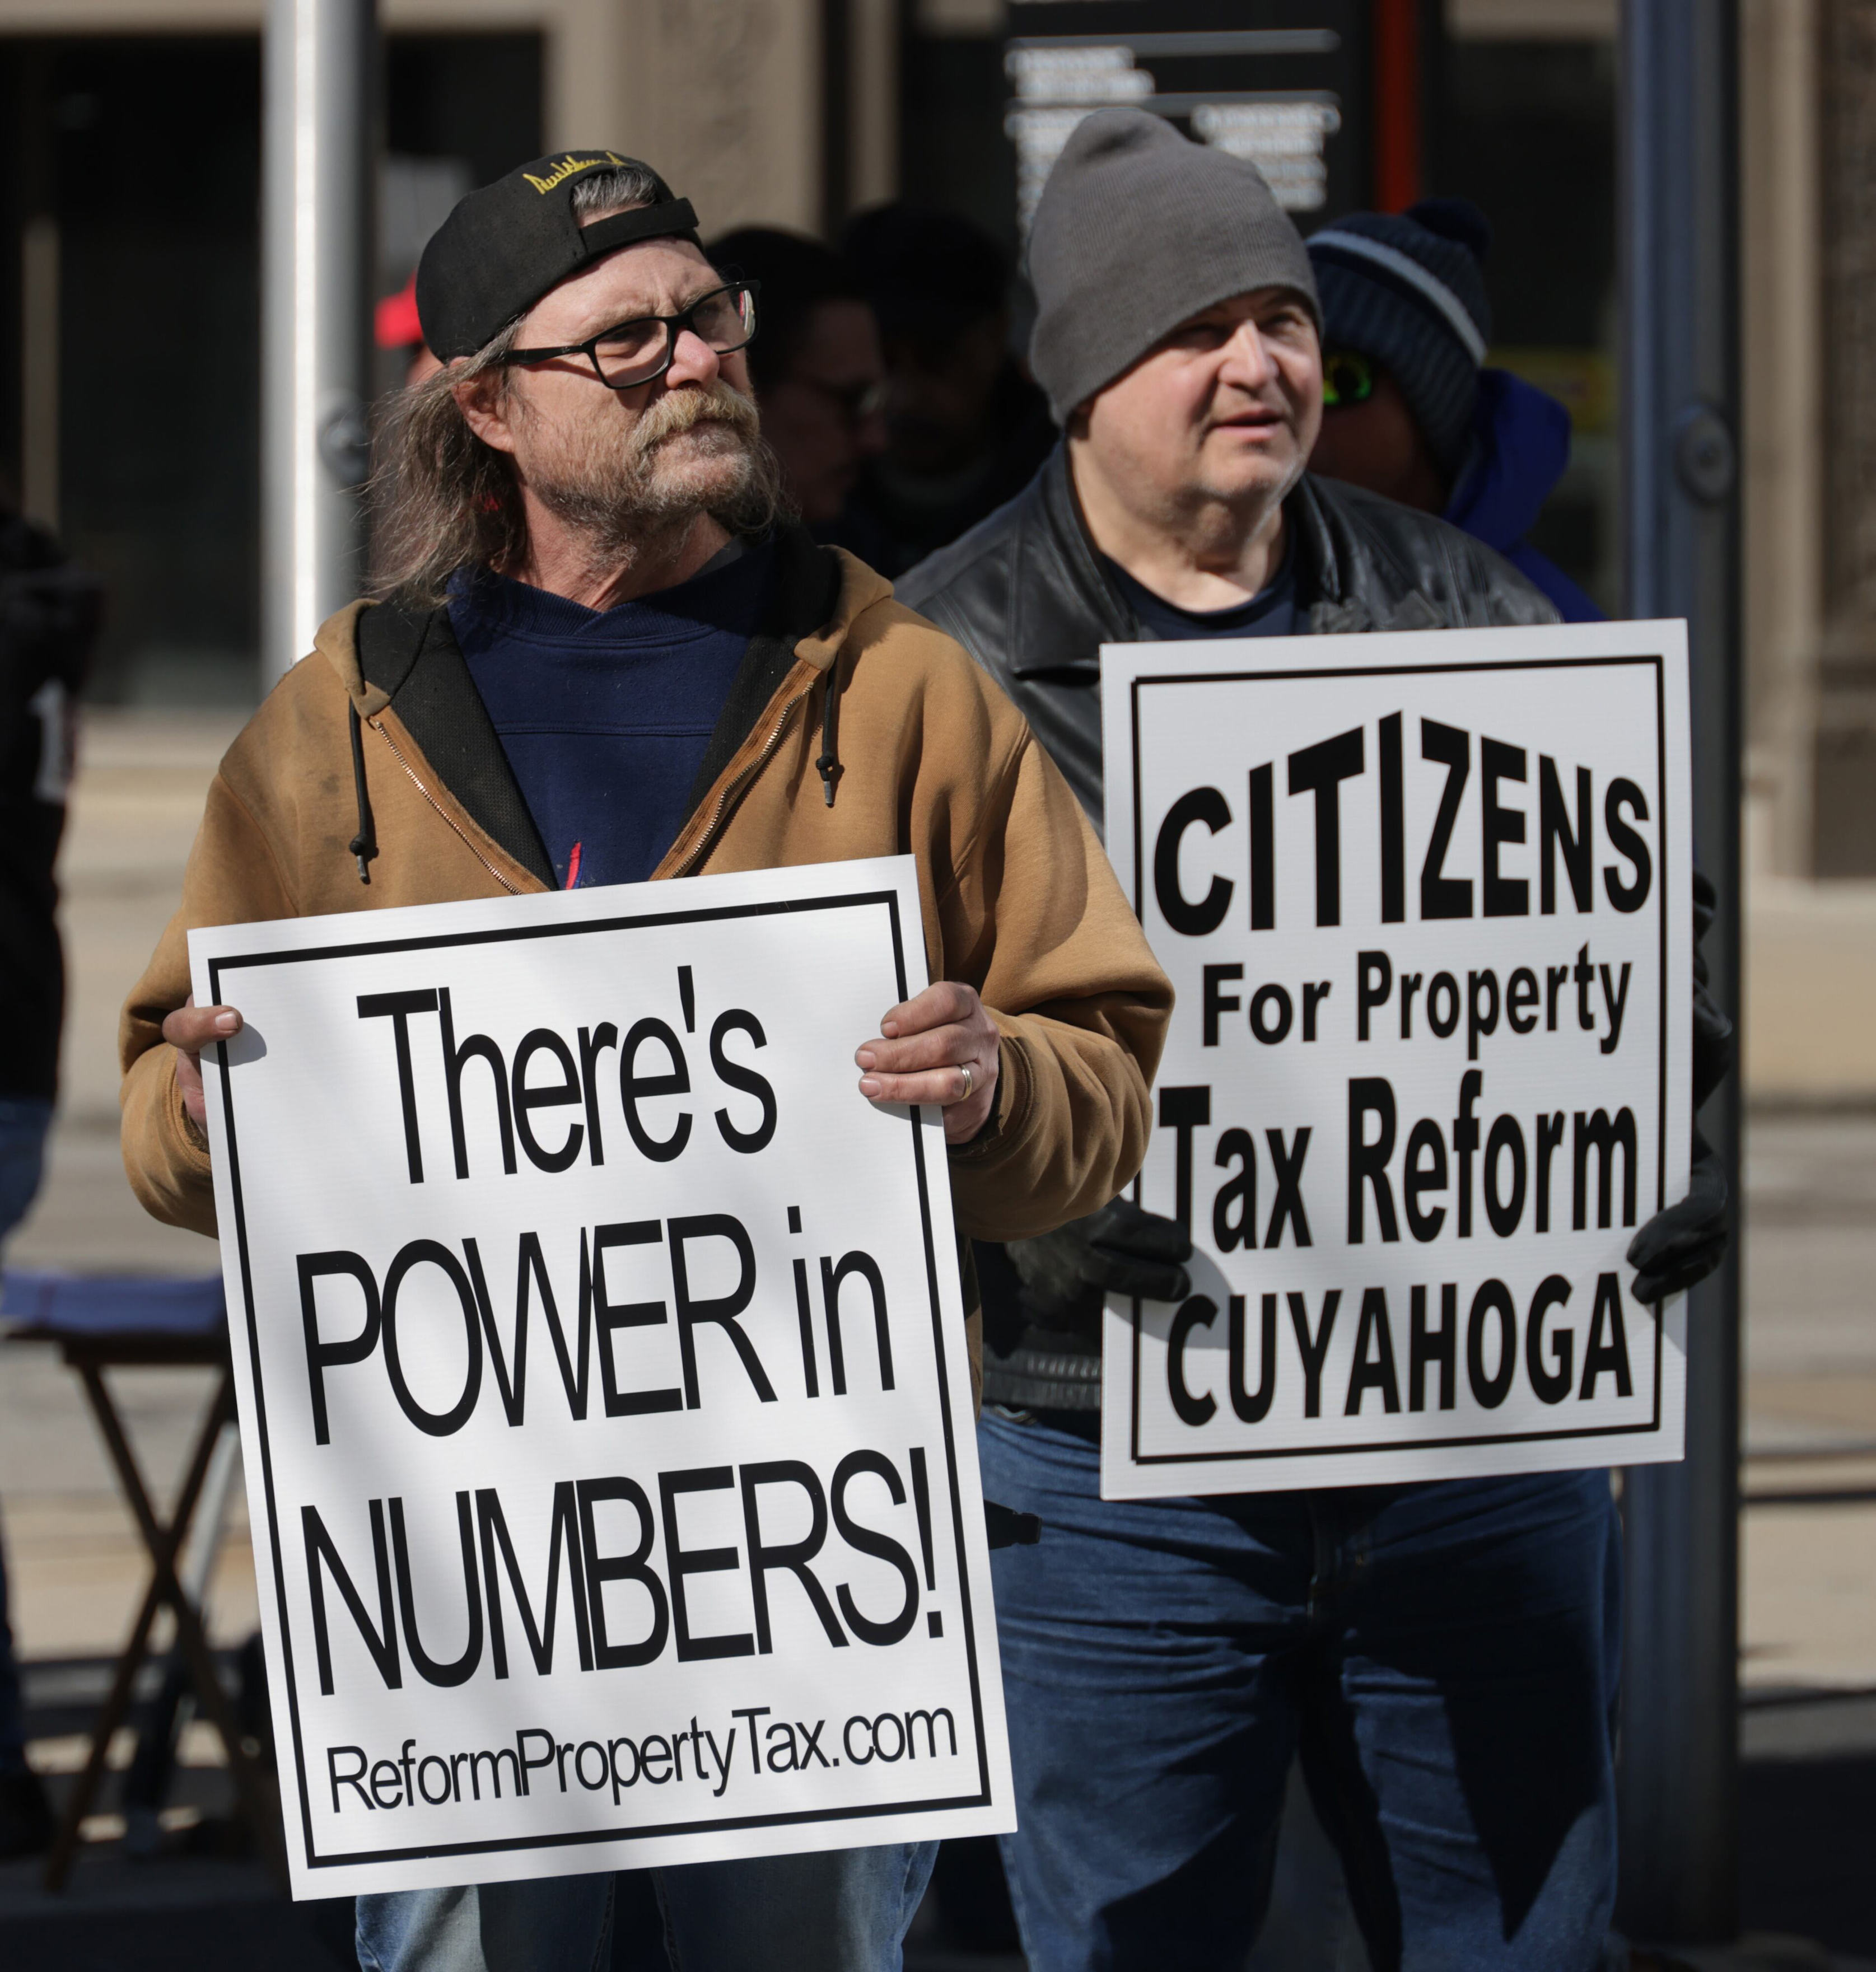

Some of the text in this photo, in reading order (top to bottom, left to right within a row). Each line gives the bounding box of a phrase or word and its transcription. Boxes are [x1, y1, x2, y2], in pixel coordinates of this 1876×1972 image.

[1153, 711, 1652, 936] CITIZENS
[356, 965, 777, 1184] There's
[1202, 941, 1632, 1060] For Property
[1159, 1069, 1637, 1253] Tax Reform
[295, 1205, 896, 1445] POWER in
[1167, 1272, 1634, 1427] CUYAHOGA
[300, 1446, 944, 1697] NUMBERS!
[327, 1707, 957, 1814] ReformPropertyTax.com
